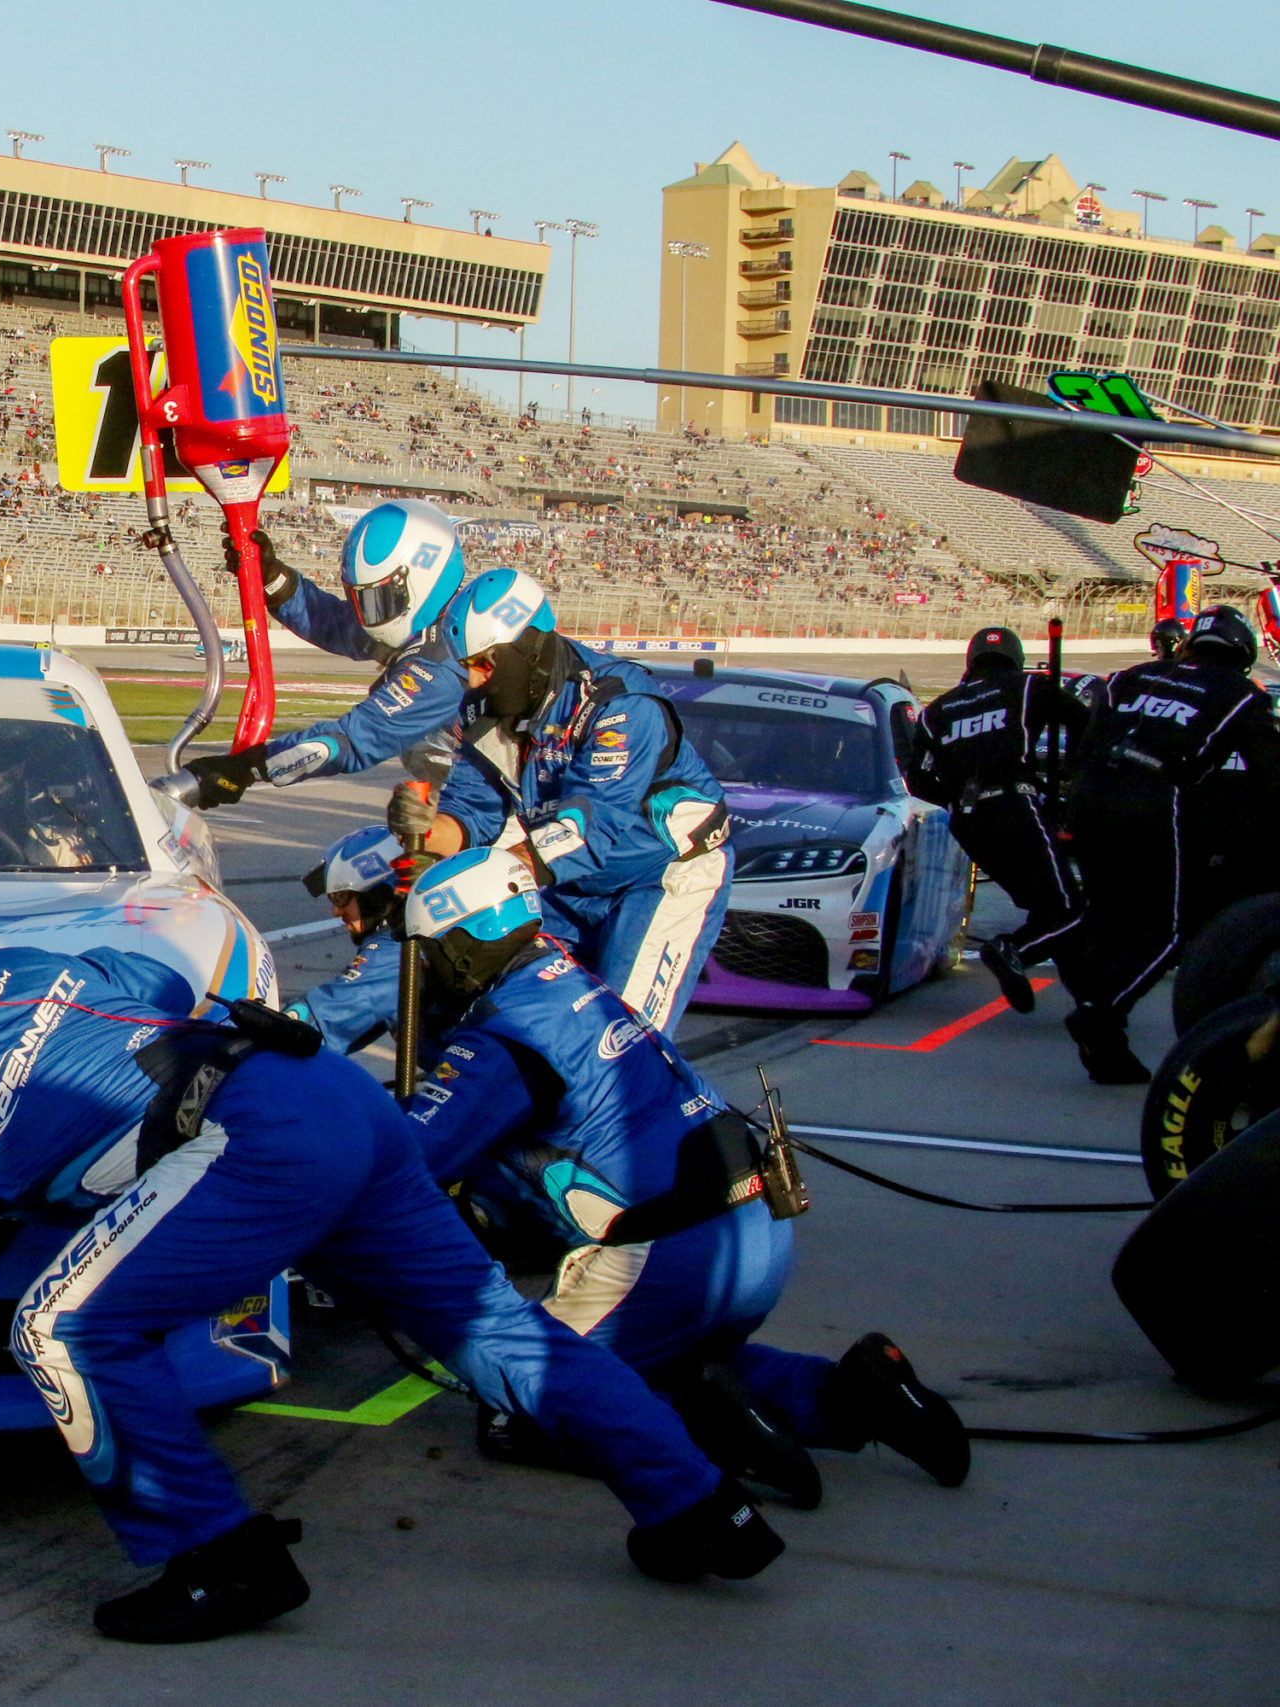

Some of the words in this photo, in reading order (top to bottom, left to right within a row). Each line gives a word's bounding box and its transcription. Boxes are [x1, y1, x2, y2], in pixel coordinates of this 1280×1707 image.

[239, 258, 276, 401] SUNOCO
[410, 542, 443, 570] 21
[493, 594, 532, 630] 21
[757, 692, 828, 709] CREED
[1117, 693, 1200, 727] JGR
[940, 707, 1008, 746] JGR
[592, 754, 628, 763] COMETIC
[351, 850, 396, 880] 21
[422, 885, 468, 925] 21
[778, 898, 822, 910] JGR
[19, 1017, 61, 1088] TRANSPORTATION
[1160, 1065, 1203, 1180] EAGLE
[93, 1247, 103, 1259] &
[102, 1190, 158, 1250] LOGISTICS
[733, 1506, 751, 1525] OMP
